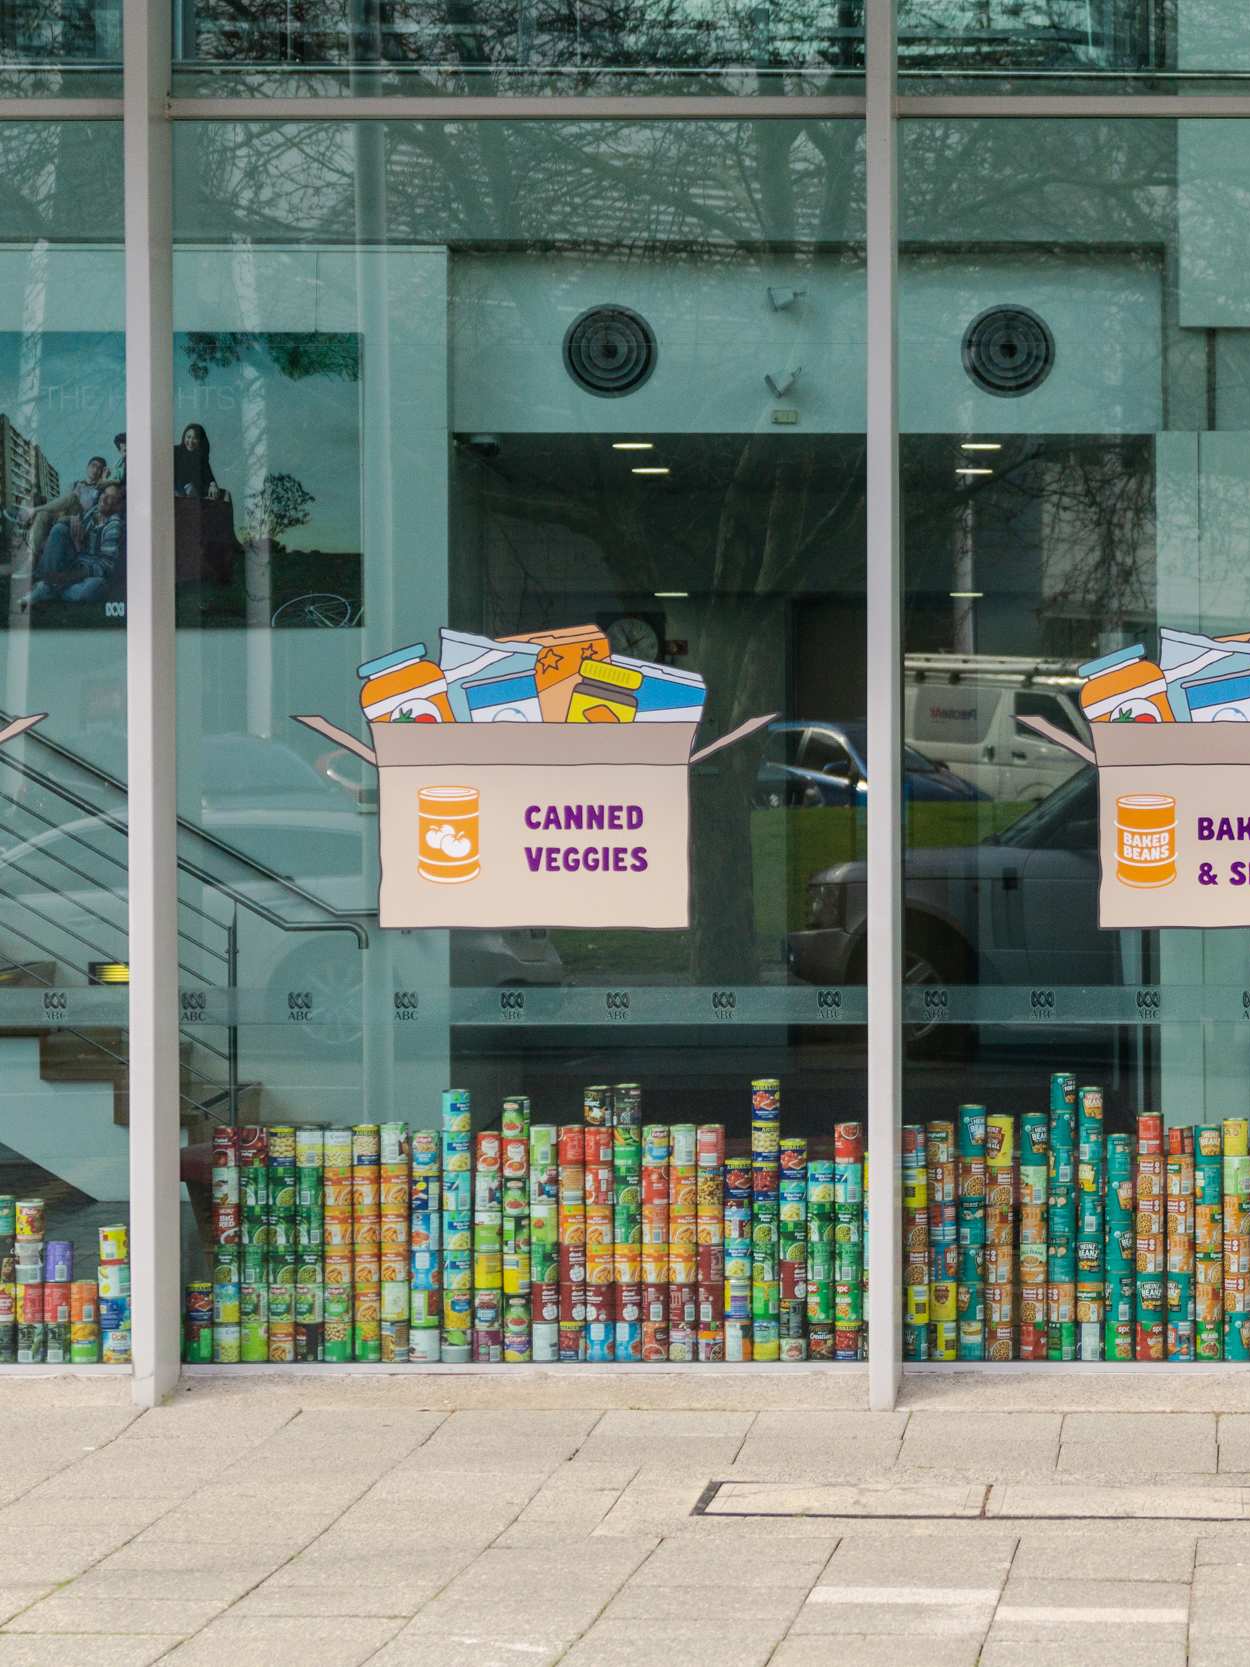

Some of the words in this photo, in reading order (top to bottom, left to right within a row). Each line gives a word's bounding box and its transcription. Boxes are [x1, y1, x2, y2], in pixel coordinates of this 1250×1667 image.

[524, 804, 644, 831] CANNED
[1122, 832, 1169, 848] BAKED
[524, 846, 649, 872] VEGGIES
[1122, 845, 1169, 861] BEANS
[1197, 861, 1219, 885] &
[182, 1011, 206, 1021] ABC
[288, 1011, 311, 1021] ABC
[394, 1011, 417, 1021] ABC
